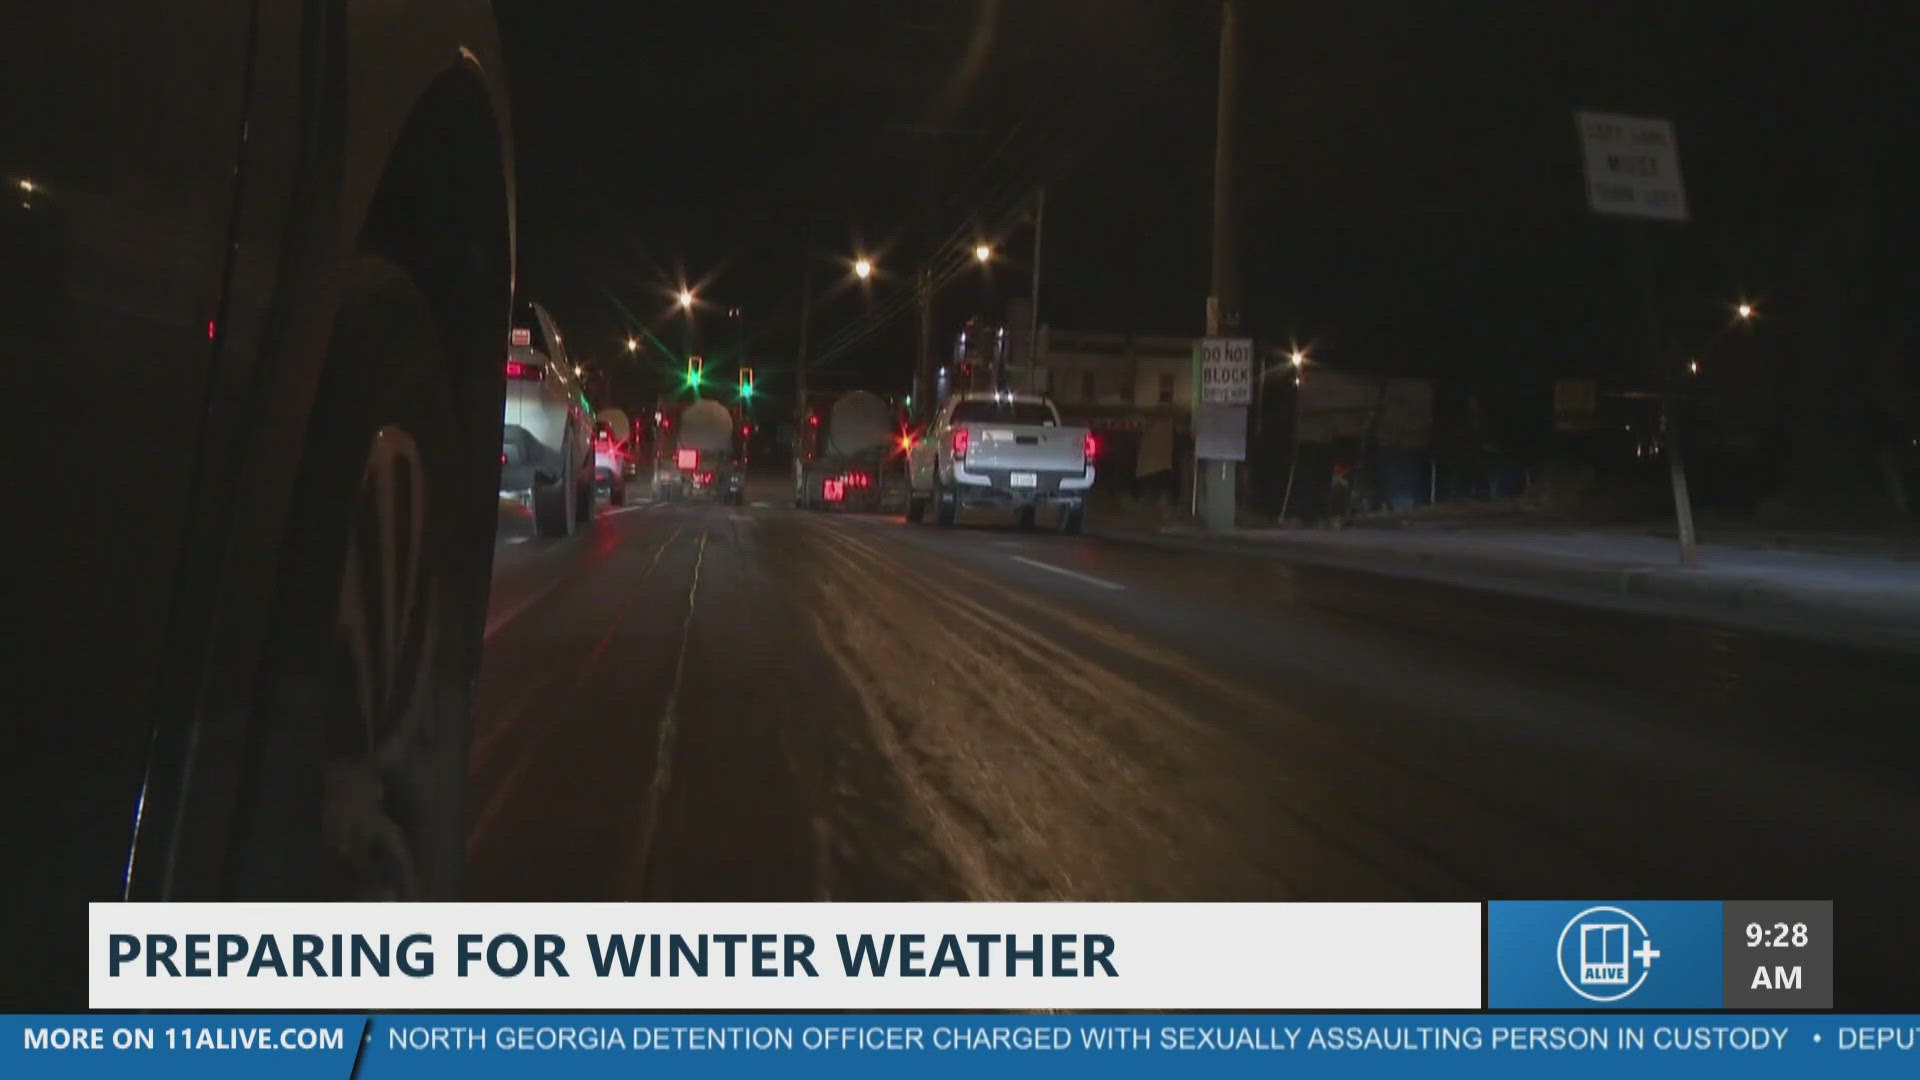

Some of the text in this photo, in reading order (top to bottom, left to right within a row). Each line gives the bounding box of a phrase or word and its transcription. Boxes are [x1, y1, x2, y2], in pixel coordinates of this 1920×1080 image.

[1203, 347, 1249, 362] DO NOT
[1203, 367, 1248, 383] BLOCK
